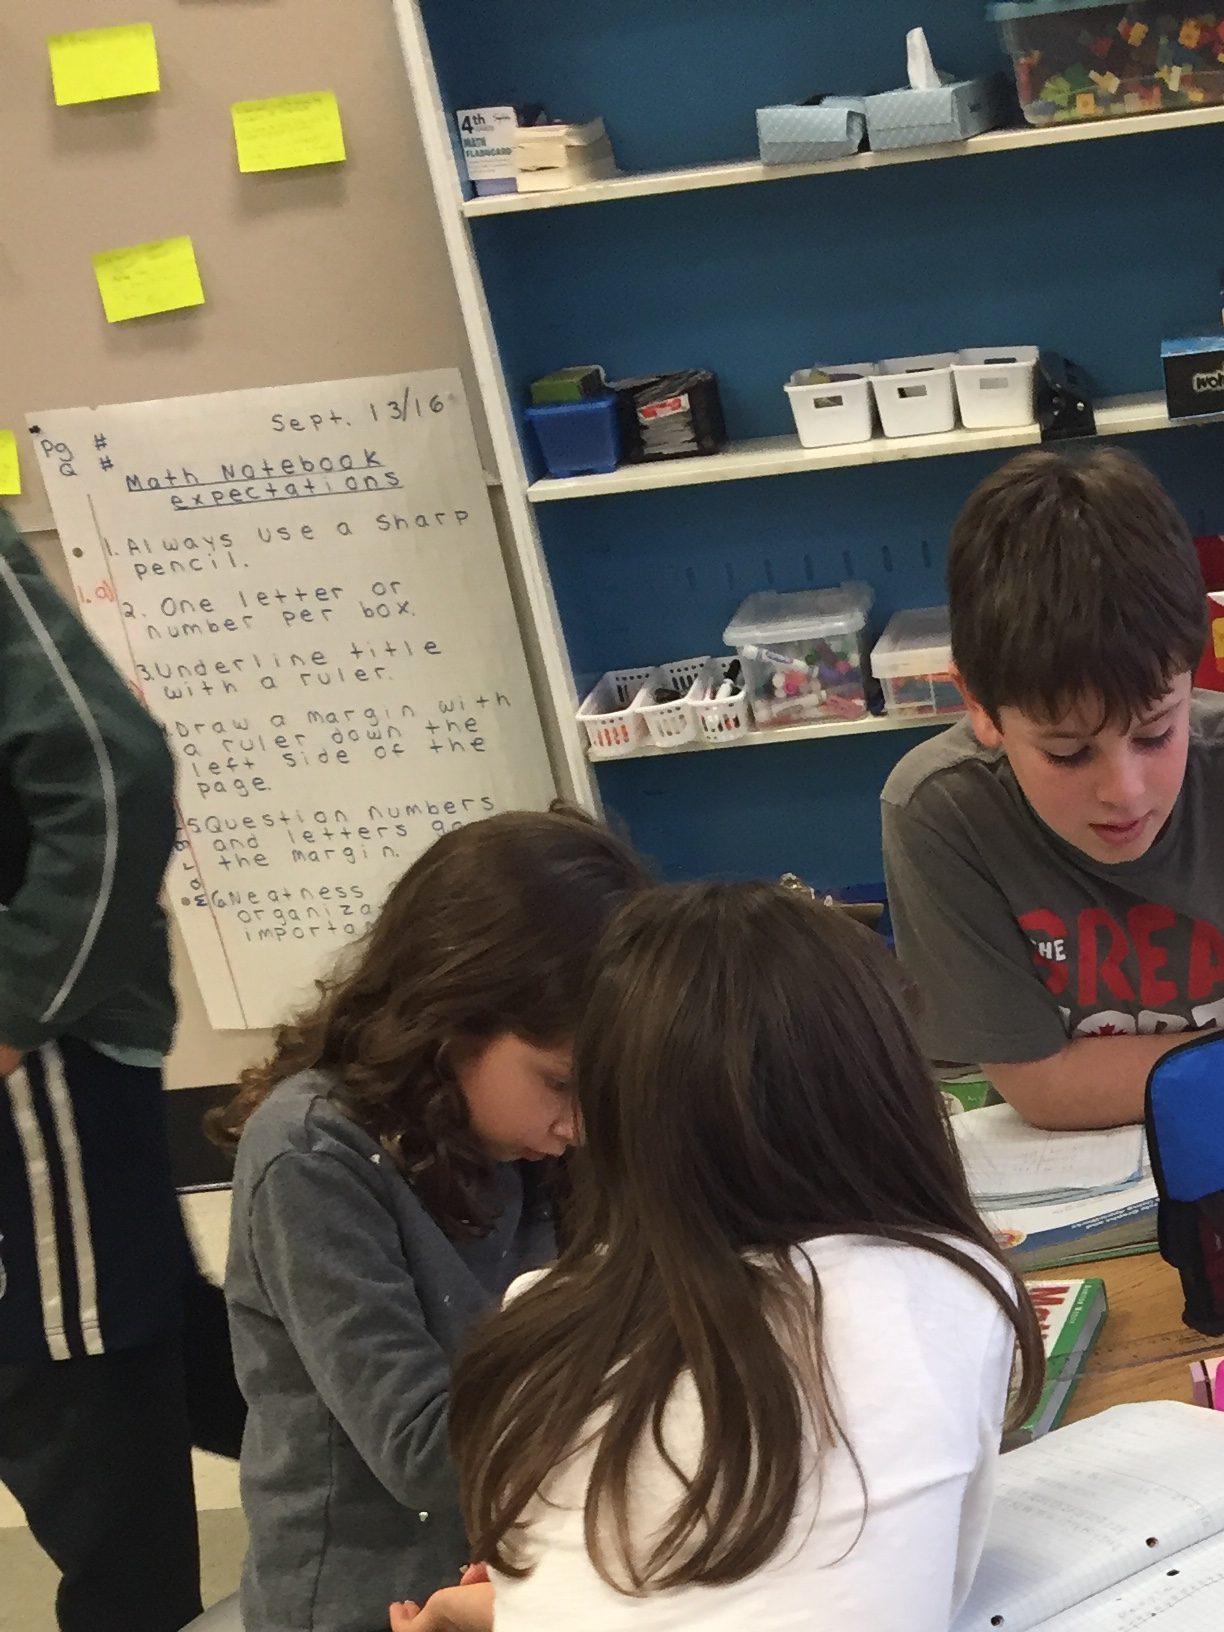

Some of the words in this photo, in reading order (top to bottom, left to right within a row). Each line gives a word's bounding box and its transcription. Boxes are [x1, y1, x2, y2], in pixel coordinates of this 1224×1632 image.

[461, 113, 486, 134] 4th
[272, 409, 352, 432] Sept.
[370, 387, 444, 421] 13/16
[126, 467, 199, 490] Math
[221, 449, 381, 481] Notebook
[170, 471, 400, 508] expectations
[103, 537, 119, 556] 1.
[127, 533, 233, 557] Always
[258, 525, 314, 543] use
[337, 522, 353, 536] a
[134, 552, 249, 580] pencil.
[122, 602, 147, 619] 2.
[161, 597, 215, 616] One
[239, 587, 344, 608] letter
[372, 581, 401, 595] or
[148, 615, 253, 640] number
[283, 607, 333, 627] per
[360, 600, 416, 619] box.
[155, 651, 328, 679] Underline
[351, 640, 442, 660] title
[164, 680, 238, 700] with
[261, 676, 276, 690] a
[300, 667, 394, 687] ruler.
[175, 717, 249, 738] Draw
[270, 714, 286, 728] a
[307, 704, 416, 727] margin
[438, 692, 511, 714] with
[183, 743, 200, 757] a
[222, 734, 306, 752] ruler
[332, 725, 403, 745] down
[426, 717, 479, 735] the
[192, 756, 255, 778] left
[282, 748, 350, 768] side
[374, 743, 405, 760] of
[430, 737, 487, 754] the
[197, 777, 272, 799] page.
[205, 809, 349, 835] Question
[368, 796, 495, 820] numbers
[213, 833, 259, 852] and
[287, 824, 408, 844] letters
[218, 853, 270, 871] the
[291, 844, 400, 865] margin.
[228, 885, 365, 906] Neatness
[237, 903, 382, 926] organiza
[245, 920, 368, 942] importa
[1030, 938, 1067, 962] HE
